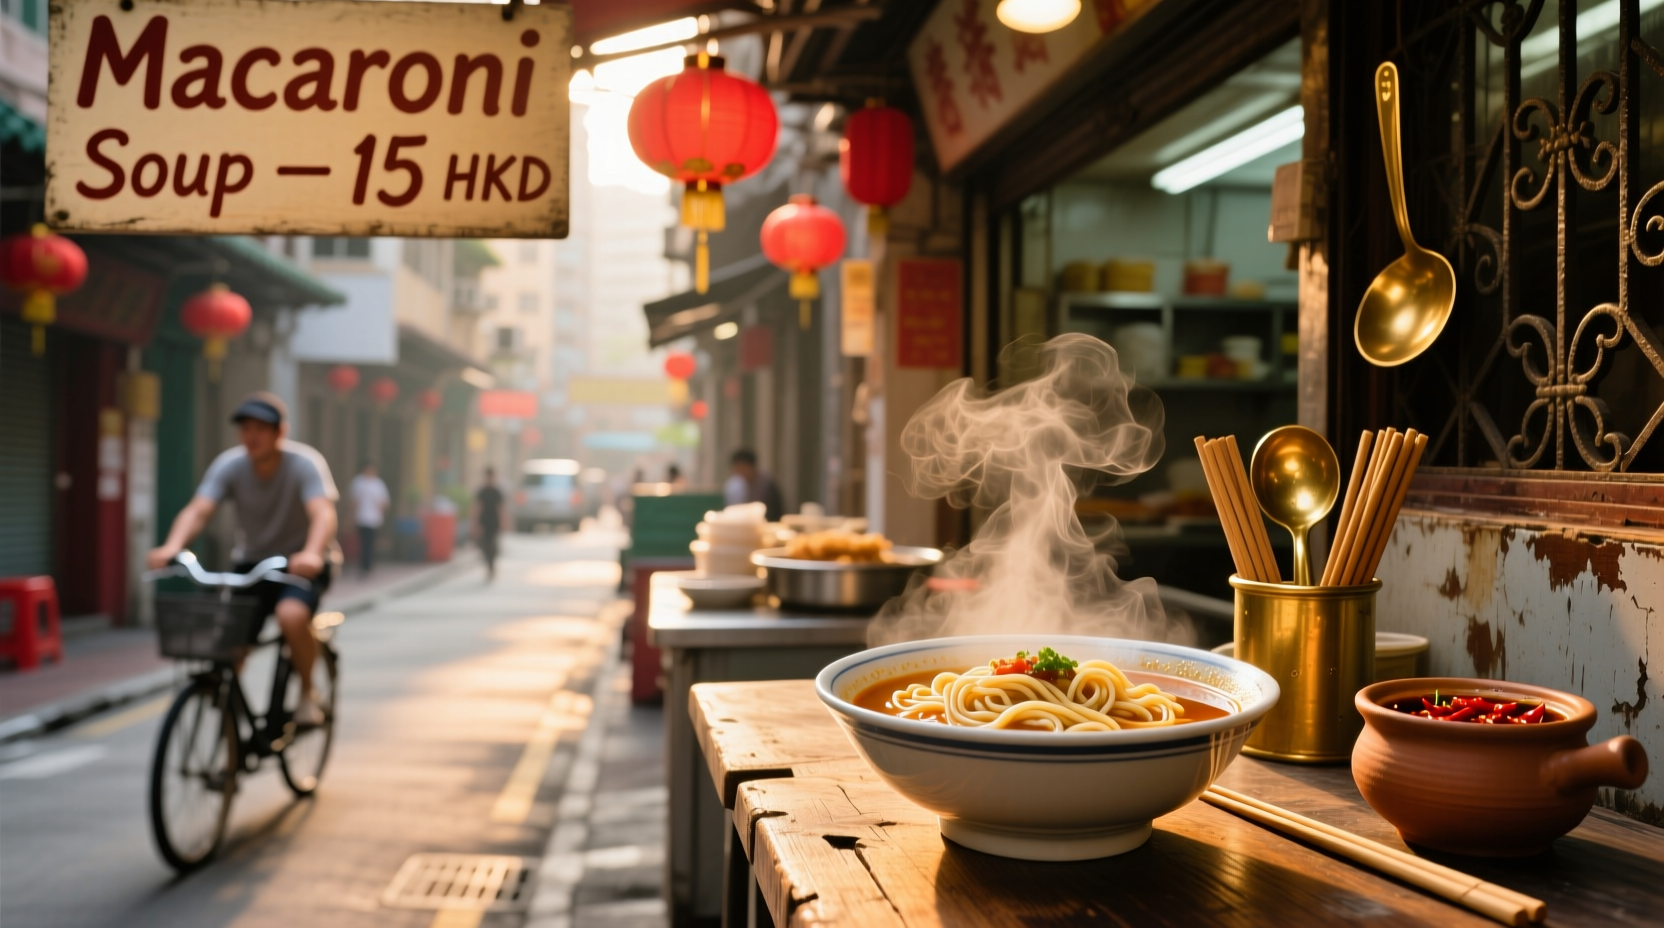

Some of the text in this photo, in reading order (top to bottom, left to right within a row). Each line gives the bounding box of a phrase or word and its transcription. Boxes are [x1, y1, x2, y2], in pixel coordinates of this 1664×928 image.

[76, 15, 541, 118] Macaroni
[75, 128, 254, 219] Soup
[352, 134, 428, 207] 15
[443, 153, 552, 203] HKD
